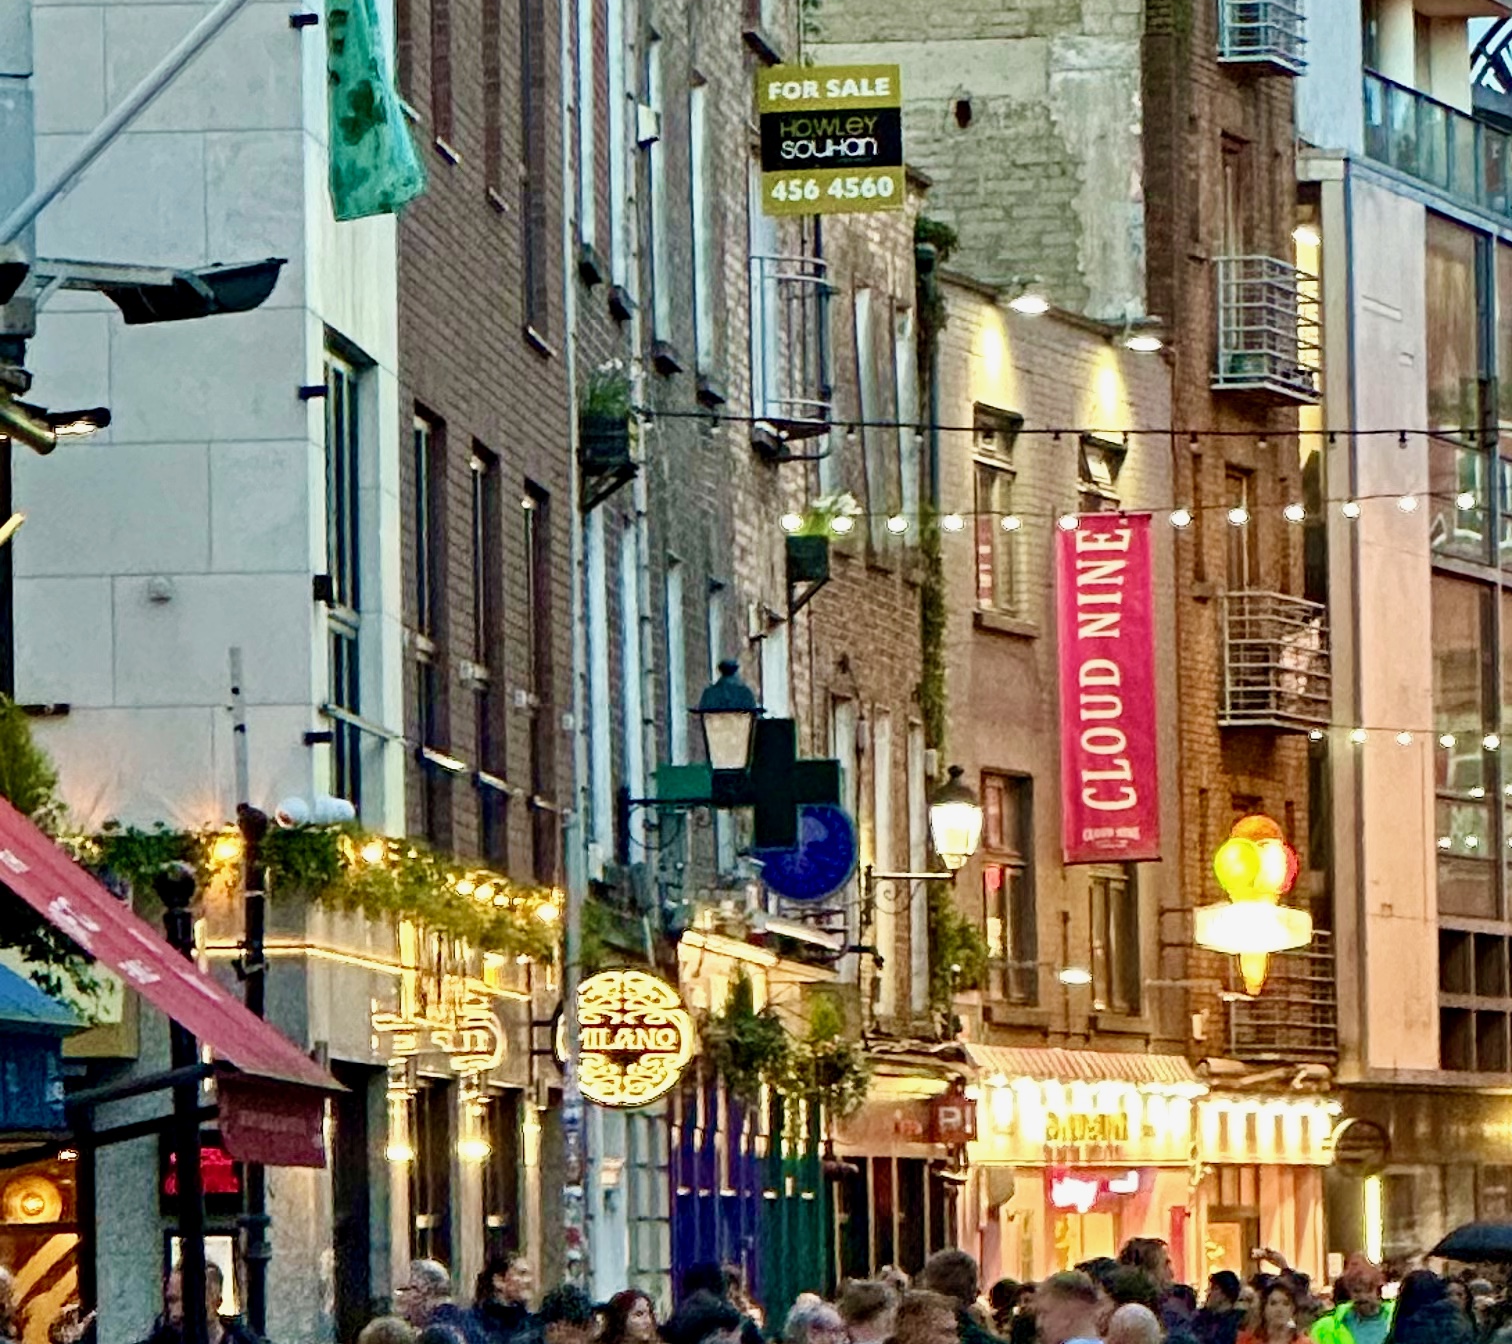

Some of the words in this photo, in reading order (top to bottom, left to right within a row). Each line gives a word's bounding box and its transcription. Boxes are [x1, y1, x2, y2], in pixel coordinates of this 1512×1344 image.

[768, 80, 820, 101] FOR
[826, 77, 891, 98] SALE
[771, 178, 820, 201] 456
[827, 175, 894, 199] 4560
[1075, 527, 1133, 641] NINE
[1077, 658, 1138, 812] CLOUD
